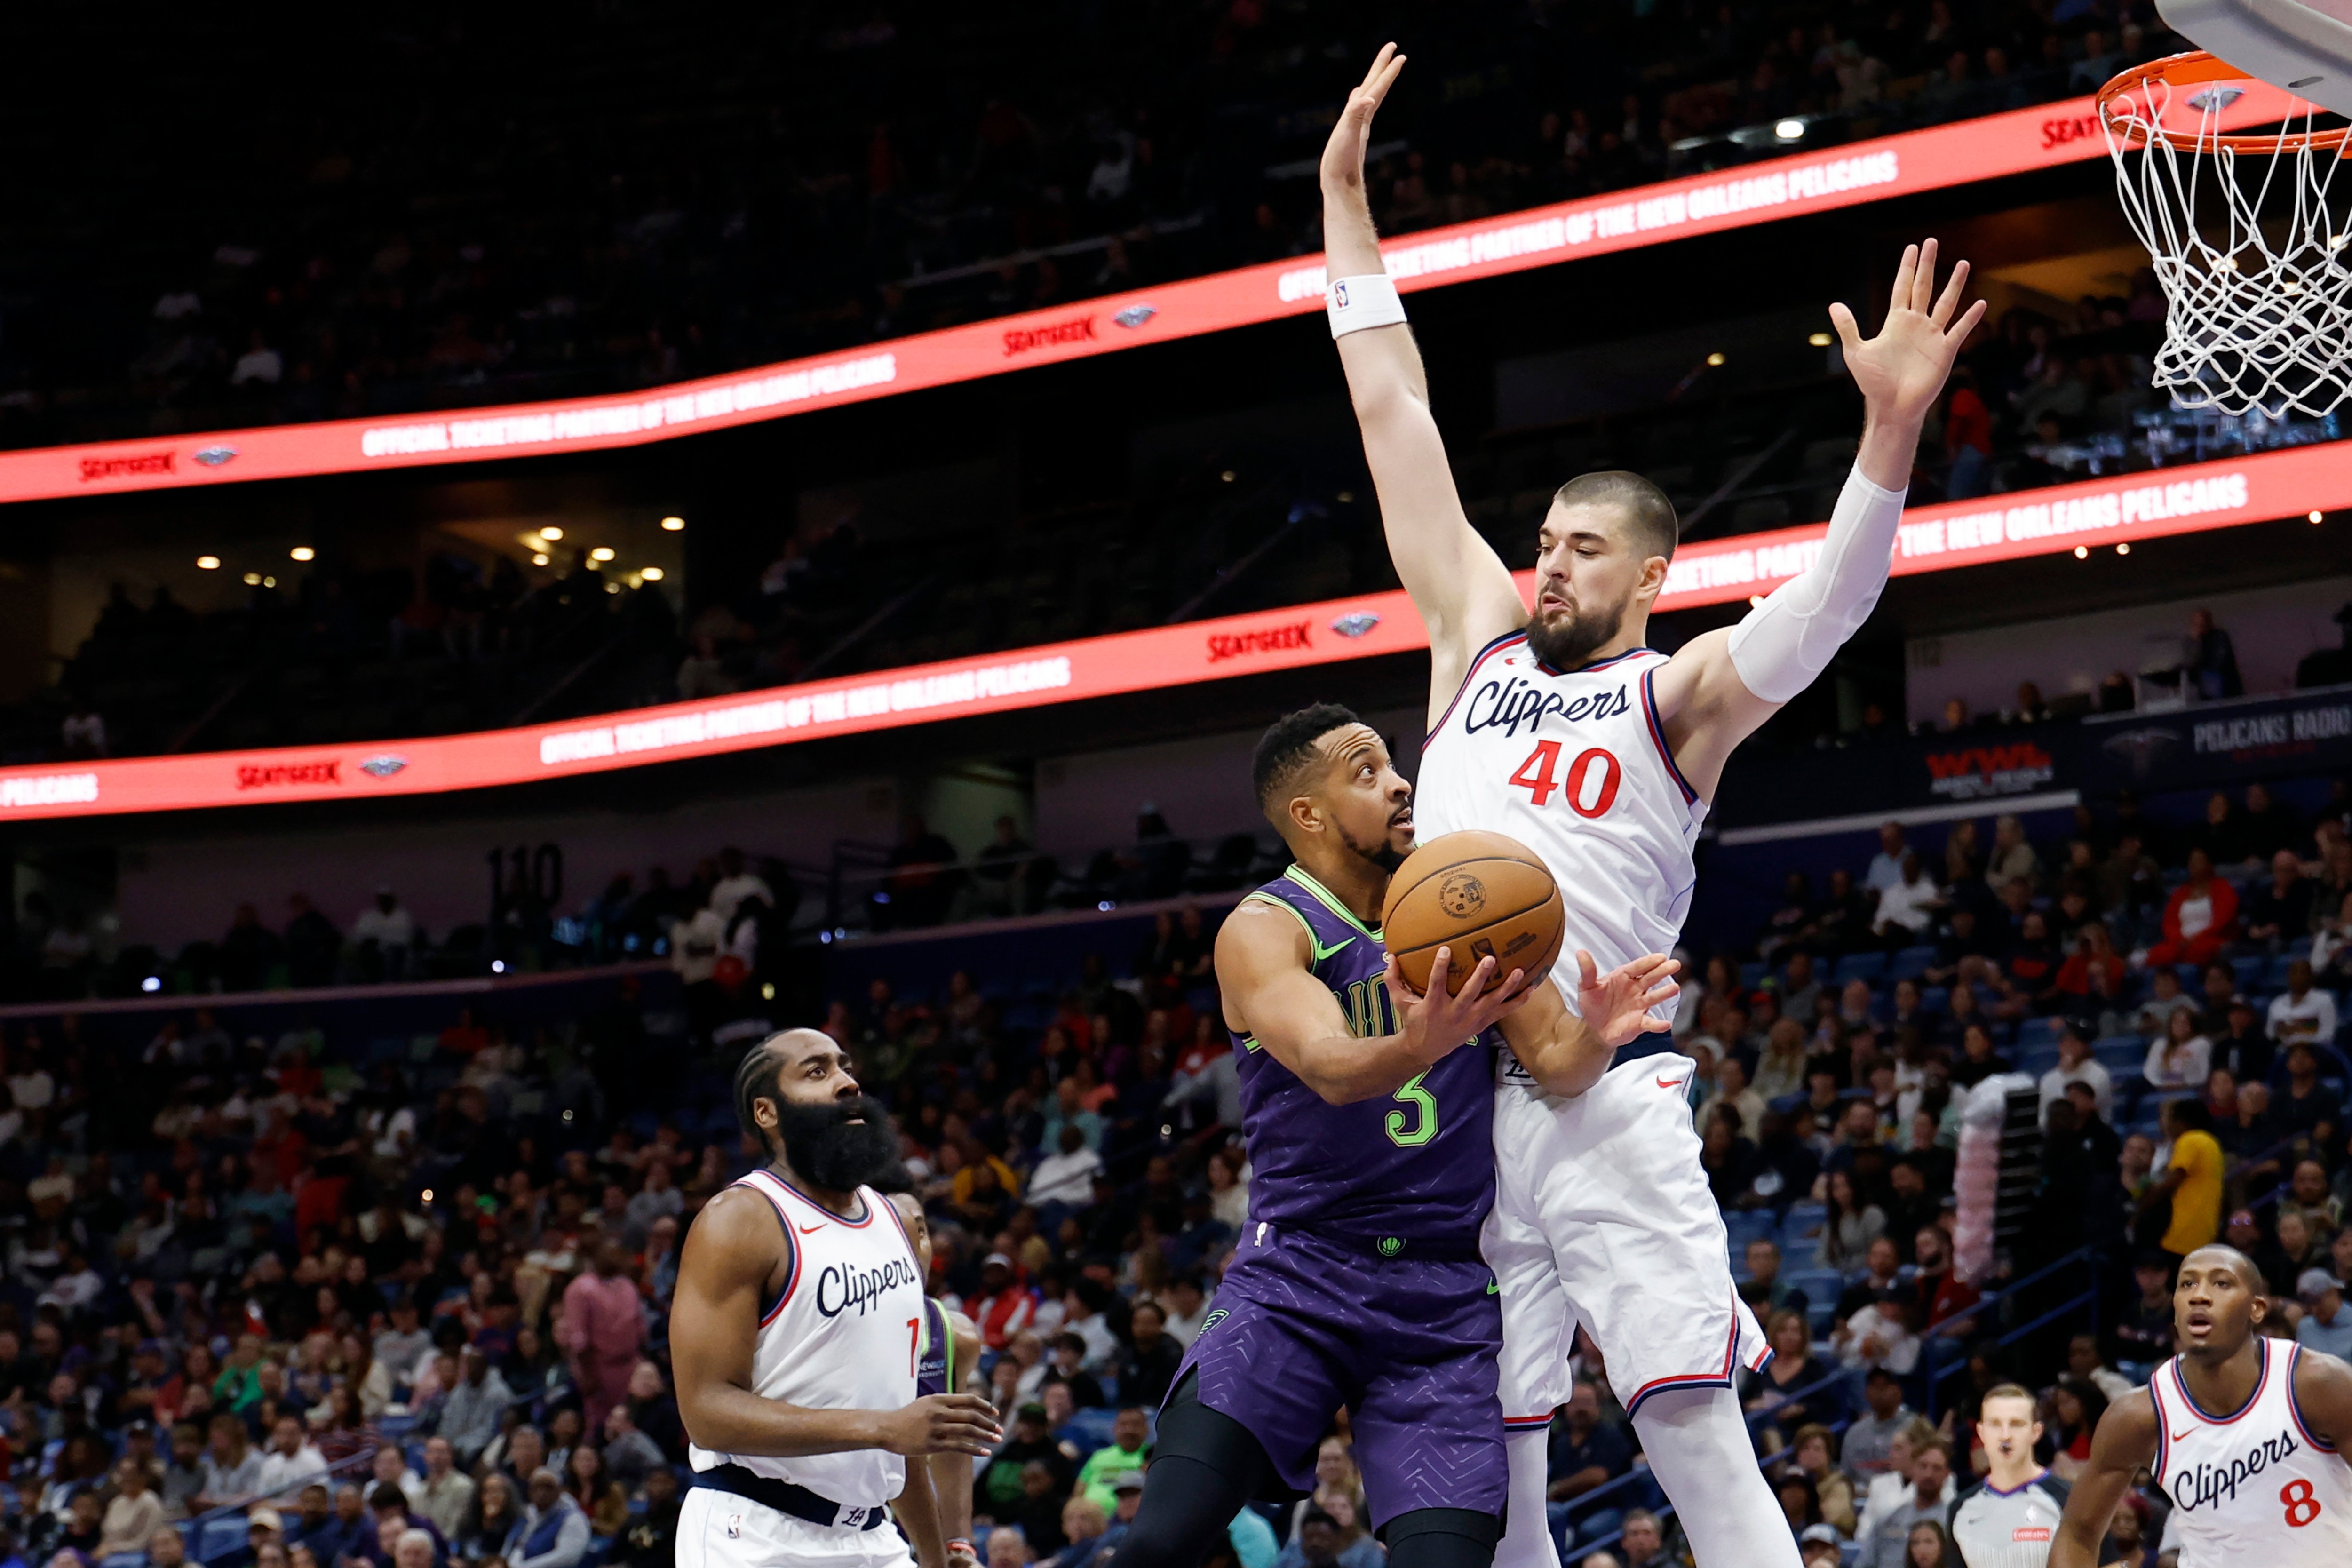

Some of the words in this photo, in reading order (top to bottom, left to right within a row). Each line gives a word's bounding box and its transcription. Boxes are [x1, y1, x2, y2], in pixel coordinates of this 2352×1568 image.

[1565, 212, 1594, 244] OF
[1596, 203, 1636, 238] THE
[1637, 193, 1685, 230] NEW
[1688, 173, 1787, 220] ORLEANS
[1789, 151, 1898, 200] PELICANS
[1898, 520, 1946, 557] THE
[1947, 511, 2003, 550] NEW
[2005, 493, 2120, 541] ORLEANS
[2122, 474, 2247, 524] PELICANS
[1466, 677, 1631, 738] Clippers
[2193, 714, 2289, 754] PELICANS
[1509, 740, 1621, 819] 40
[1384, 1065, 1438, 1148] 3
[817, 1255, 916, 1317] Clippers
[2174, 1429, 2298, 1513] Clippers
[2279, 1479, 2321, 1528] 8
